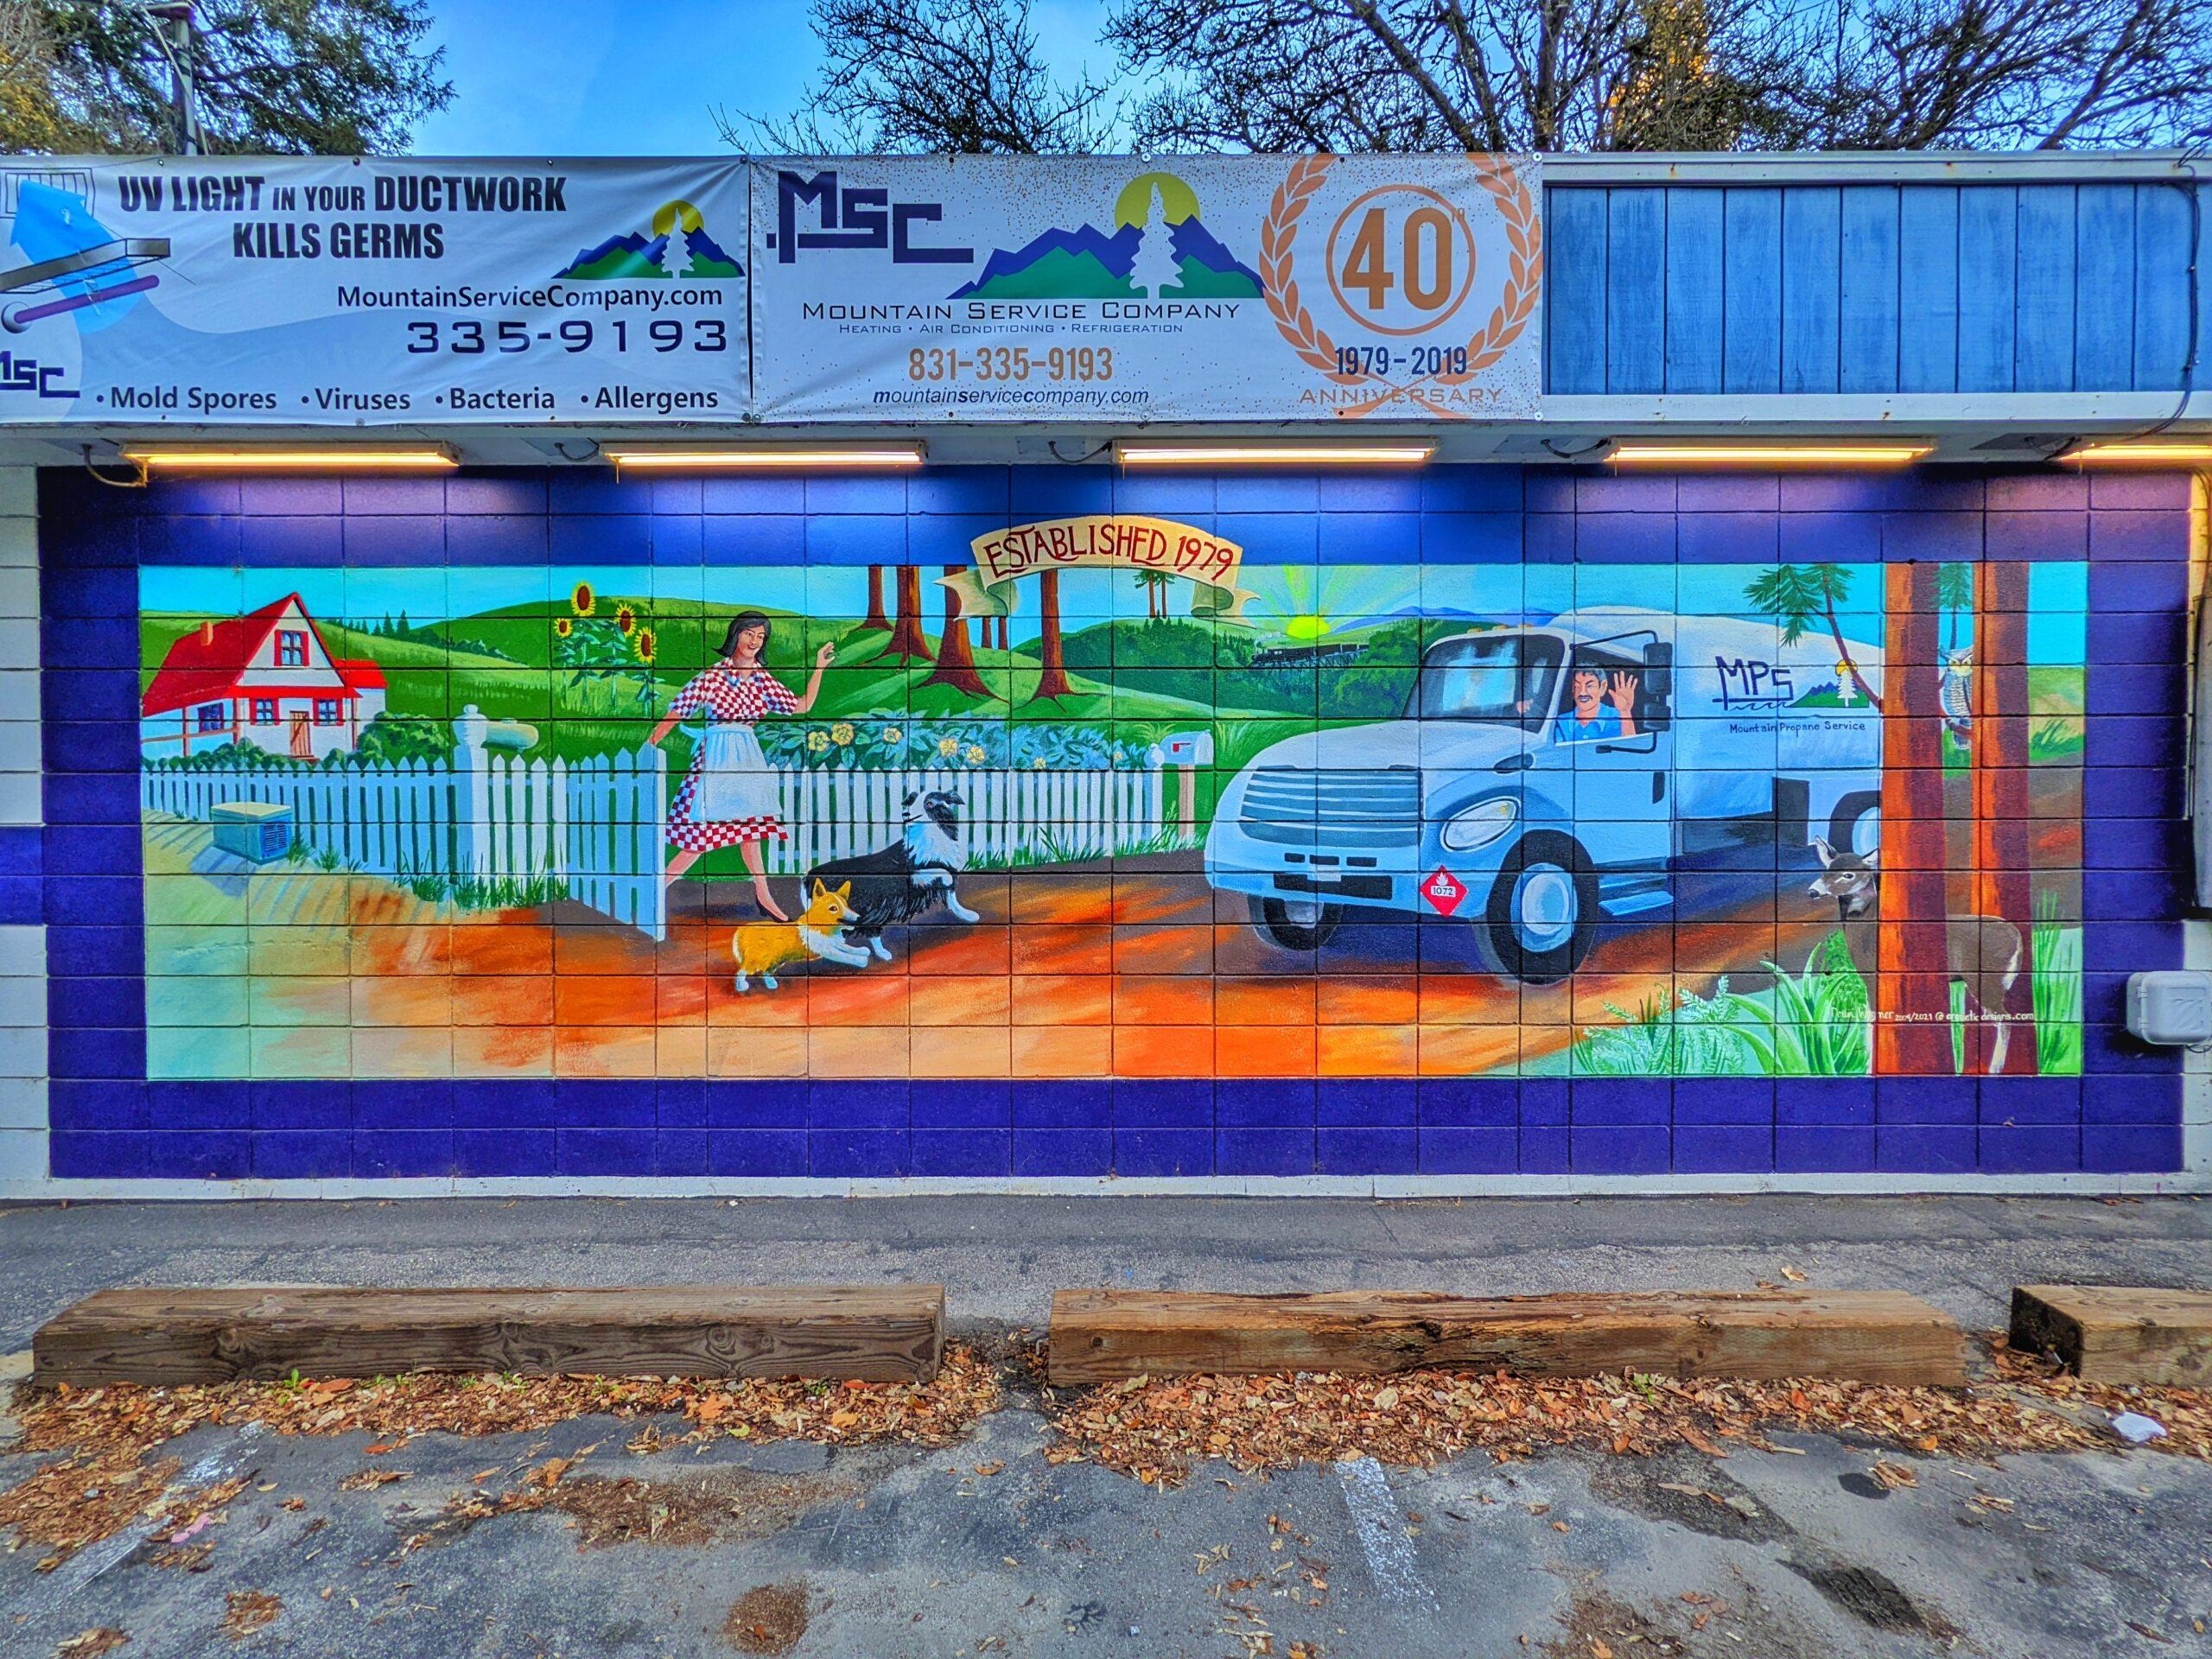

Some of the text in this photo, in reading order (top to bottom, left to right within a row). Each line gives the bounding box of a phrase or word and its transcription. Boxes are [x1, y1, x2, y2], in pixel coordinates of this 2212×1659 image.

[118, 175, 567, 212] UV LIGHT IN YOUR DUCTWORK
[766, 170, 974, 264] MSC
[232, 221, 444, 259] KILLS GERMS
[1342, 207, 1452, 311] 40
[338, 285, 722, 312] MountainServiceCompany.com
[803, 302, 1241, 321] MOUNTAIN SERVICE COMPANY
[407, 320, 728, 354] 335-9193
[839, 324, 1183, 334] HEATING AIR CONDITIONING REFRIGERATION
[908, 347, 1113, 381] 831-335-9193
[111, 386, 718, 415] Mold Spores Viruses Bacteria Allergens
[873, 387, 1149, 407] mountainservicecompany.com
[1300, 388, 1503, 404] ANNIVERSARY
[983, 524, 1234, 581] ESTABLISHED 1979
[1712, 656, 1794, 711] MPS
[1730, 721, 1866, 737] Mountain Propane Service
[1433, 887, 1453, 896] 1072
